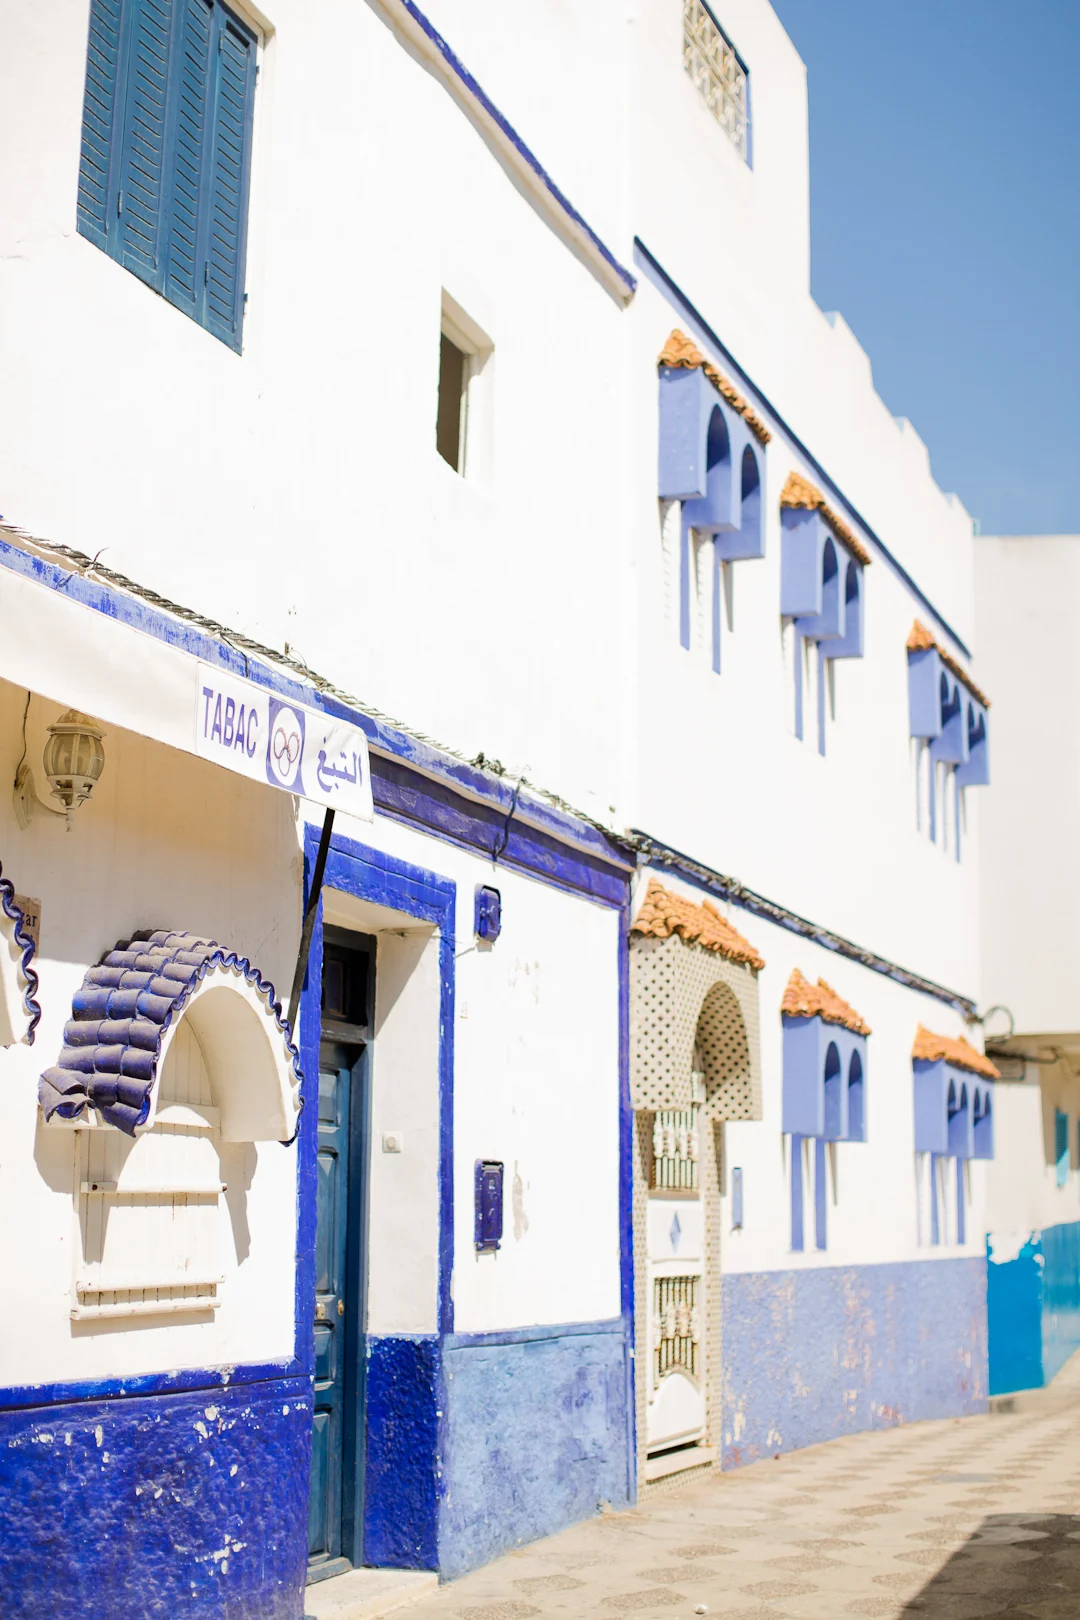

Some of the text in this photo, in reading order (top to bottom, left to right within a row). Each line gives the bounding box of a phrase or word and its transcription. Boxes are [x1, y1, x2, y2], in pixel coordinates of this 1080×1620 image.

[203, 687, 258, 758] TABAC
[317, 736, 362, 792] التبغ
[22, 913, 37, 927] ar
